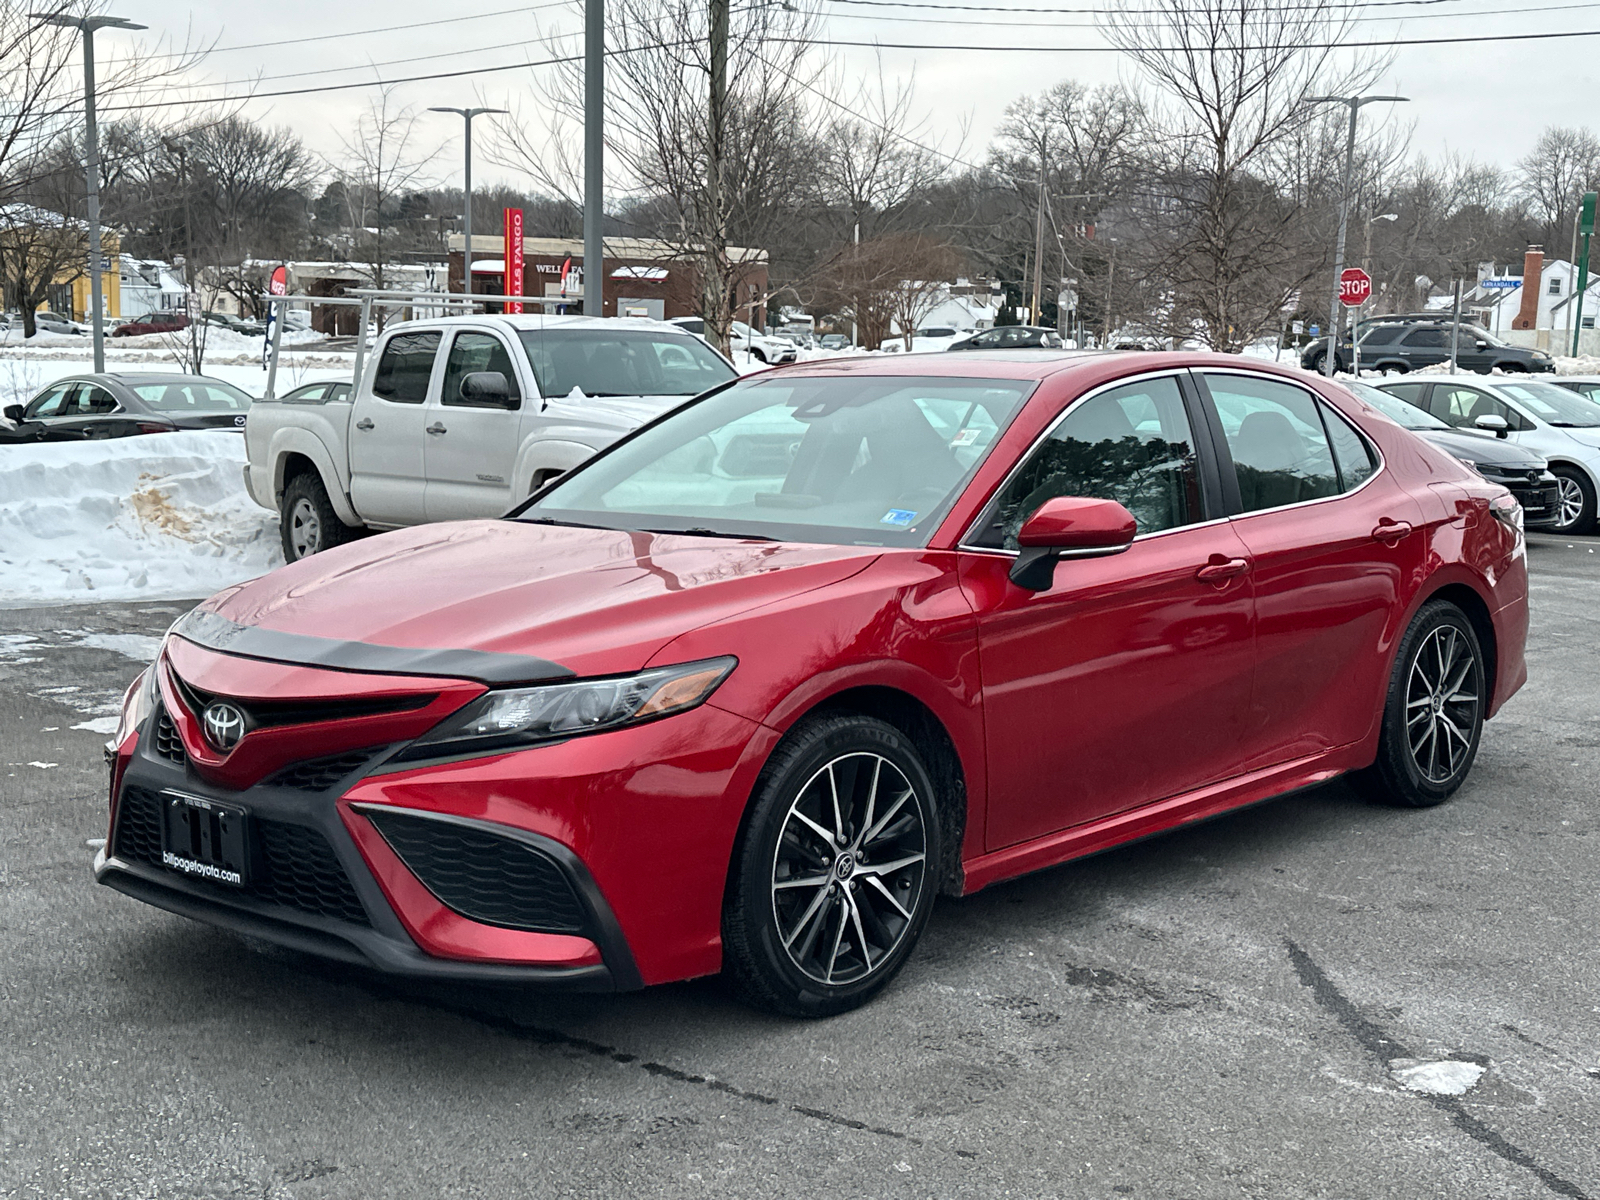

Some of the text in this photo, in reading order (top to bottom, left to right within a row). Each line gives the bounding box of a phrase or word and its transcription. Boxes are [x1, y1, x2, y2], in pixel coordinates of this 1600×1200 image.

[514, 214, 522, 314] WLLS FARGO
[536, 264, 562, 273] WELL
[1339, 280, 1369, 295] STOP
[163, 850, 241, 884] billpagetoyota.com
